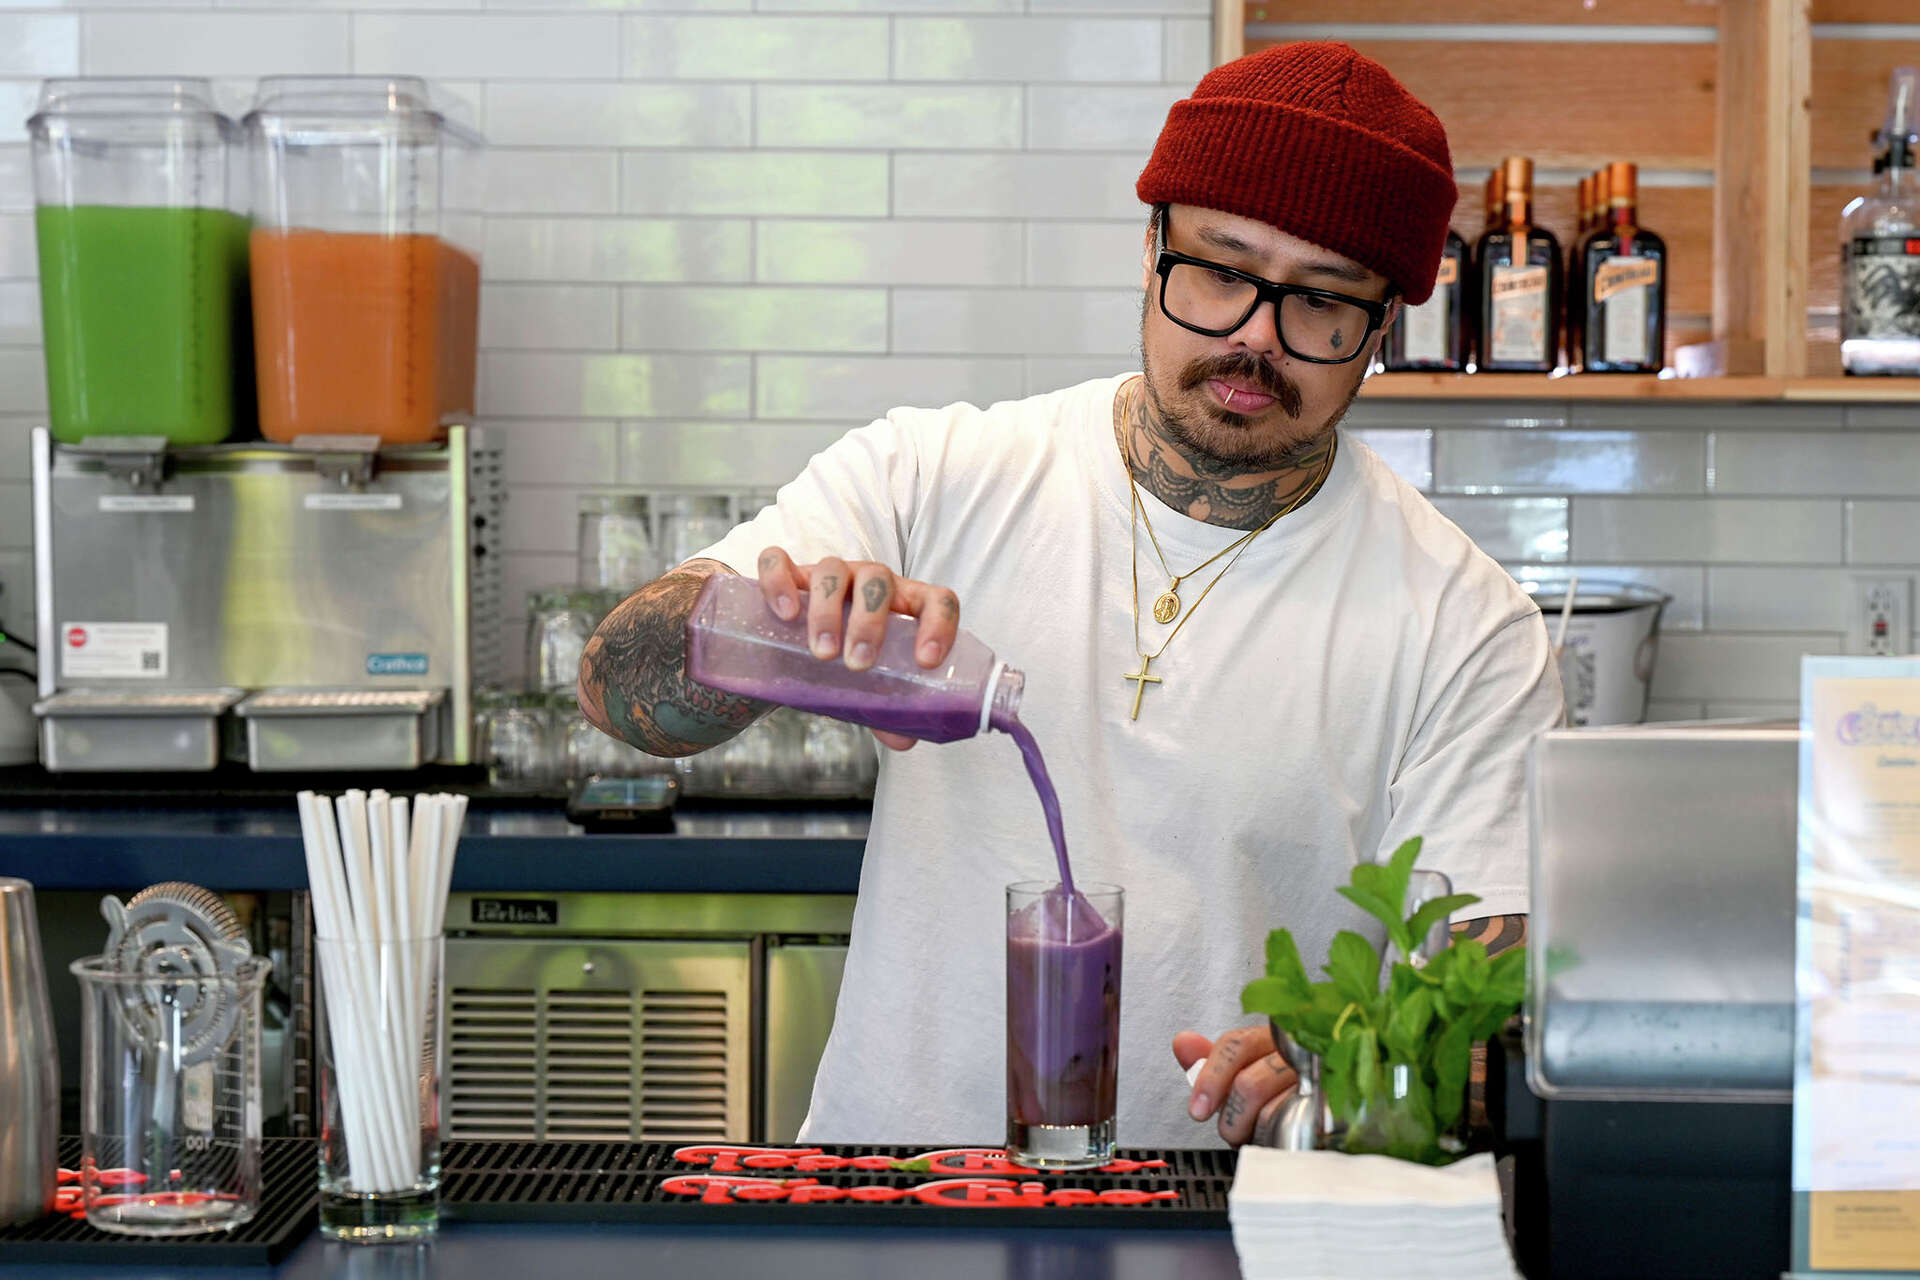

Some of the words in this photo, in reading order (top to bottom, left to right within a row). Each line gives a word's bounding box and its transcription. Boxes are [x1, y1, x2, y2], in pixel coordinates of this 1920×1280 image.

[479, 901, 552, 921] Perlick
[674, 1145, 902, 1172] Topo
[906, 1148, 1168, 1175] Cho
[661, 1175, 903, 1204] Topo
[907, 1178, 1180, 1207] Chico
